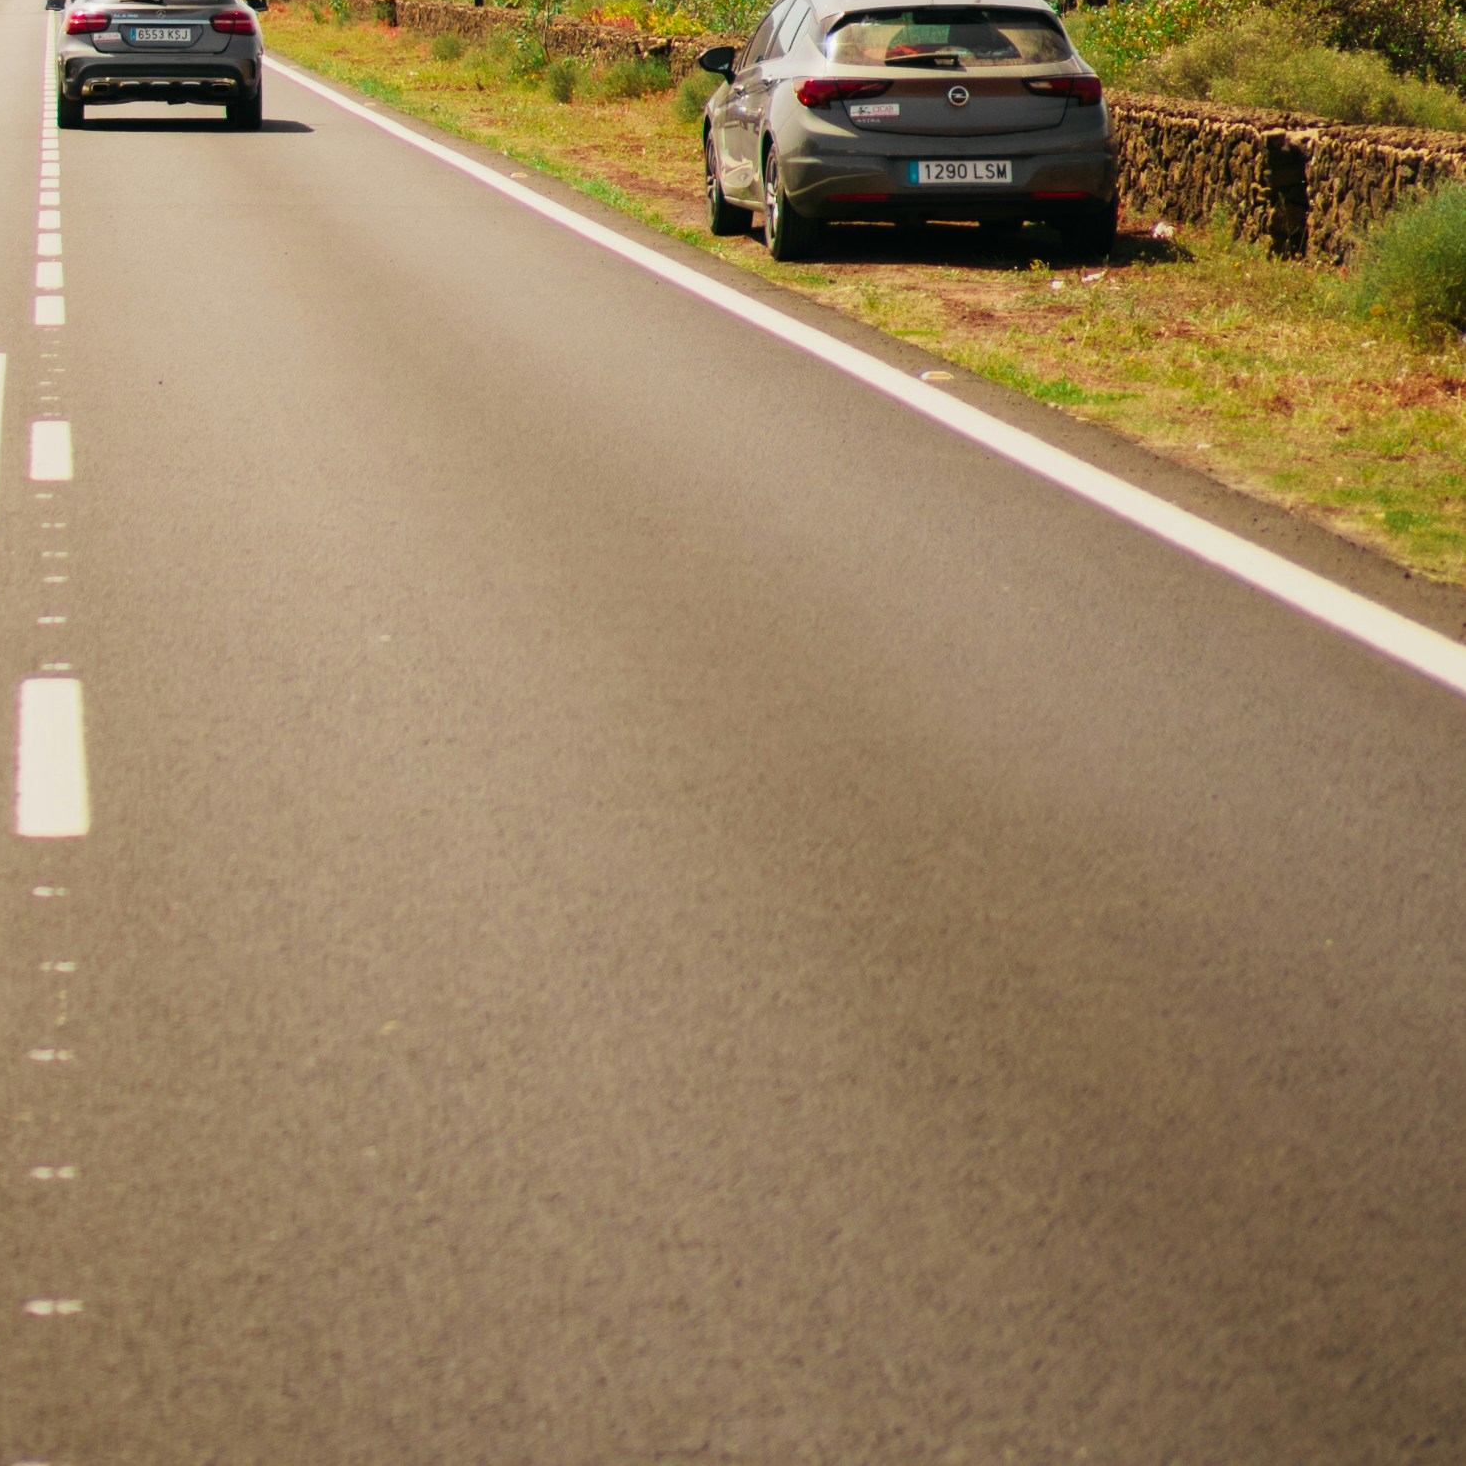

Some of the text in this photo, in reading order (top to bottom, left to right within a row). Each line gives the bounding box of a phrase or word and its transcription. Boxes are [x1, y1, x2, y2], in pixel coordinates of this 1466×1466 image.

[138, 29, 188, 40] 6553 KSJ
[925, 163, 1007, 180] 1290 LSM
